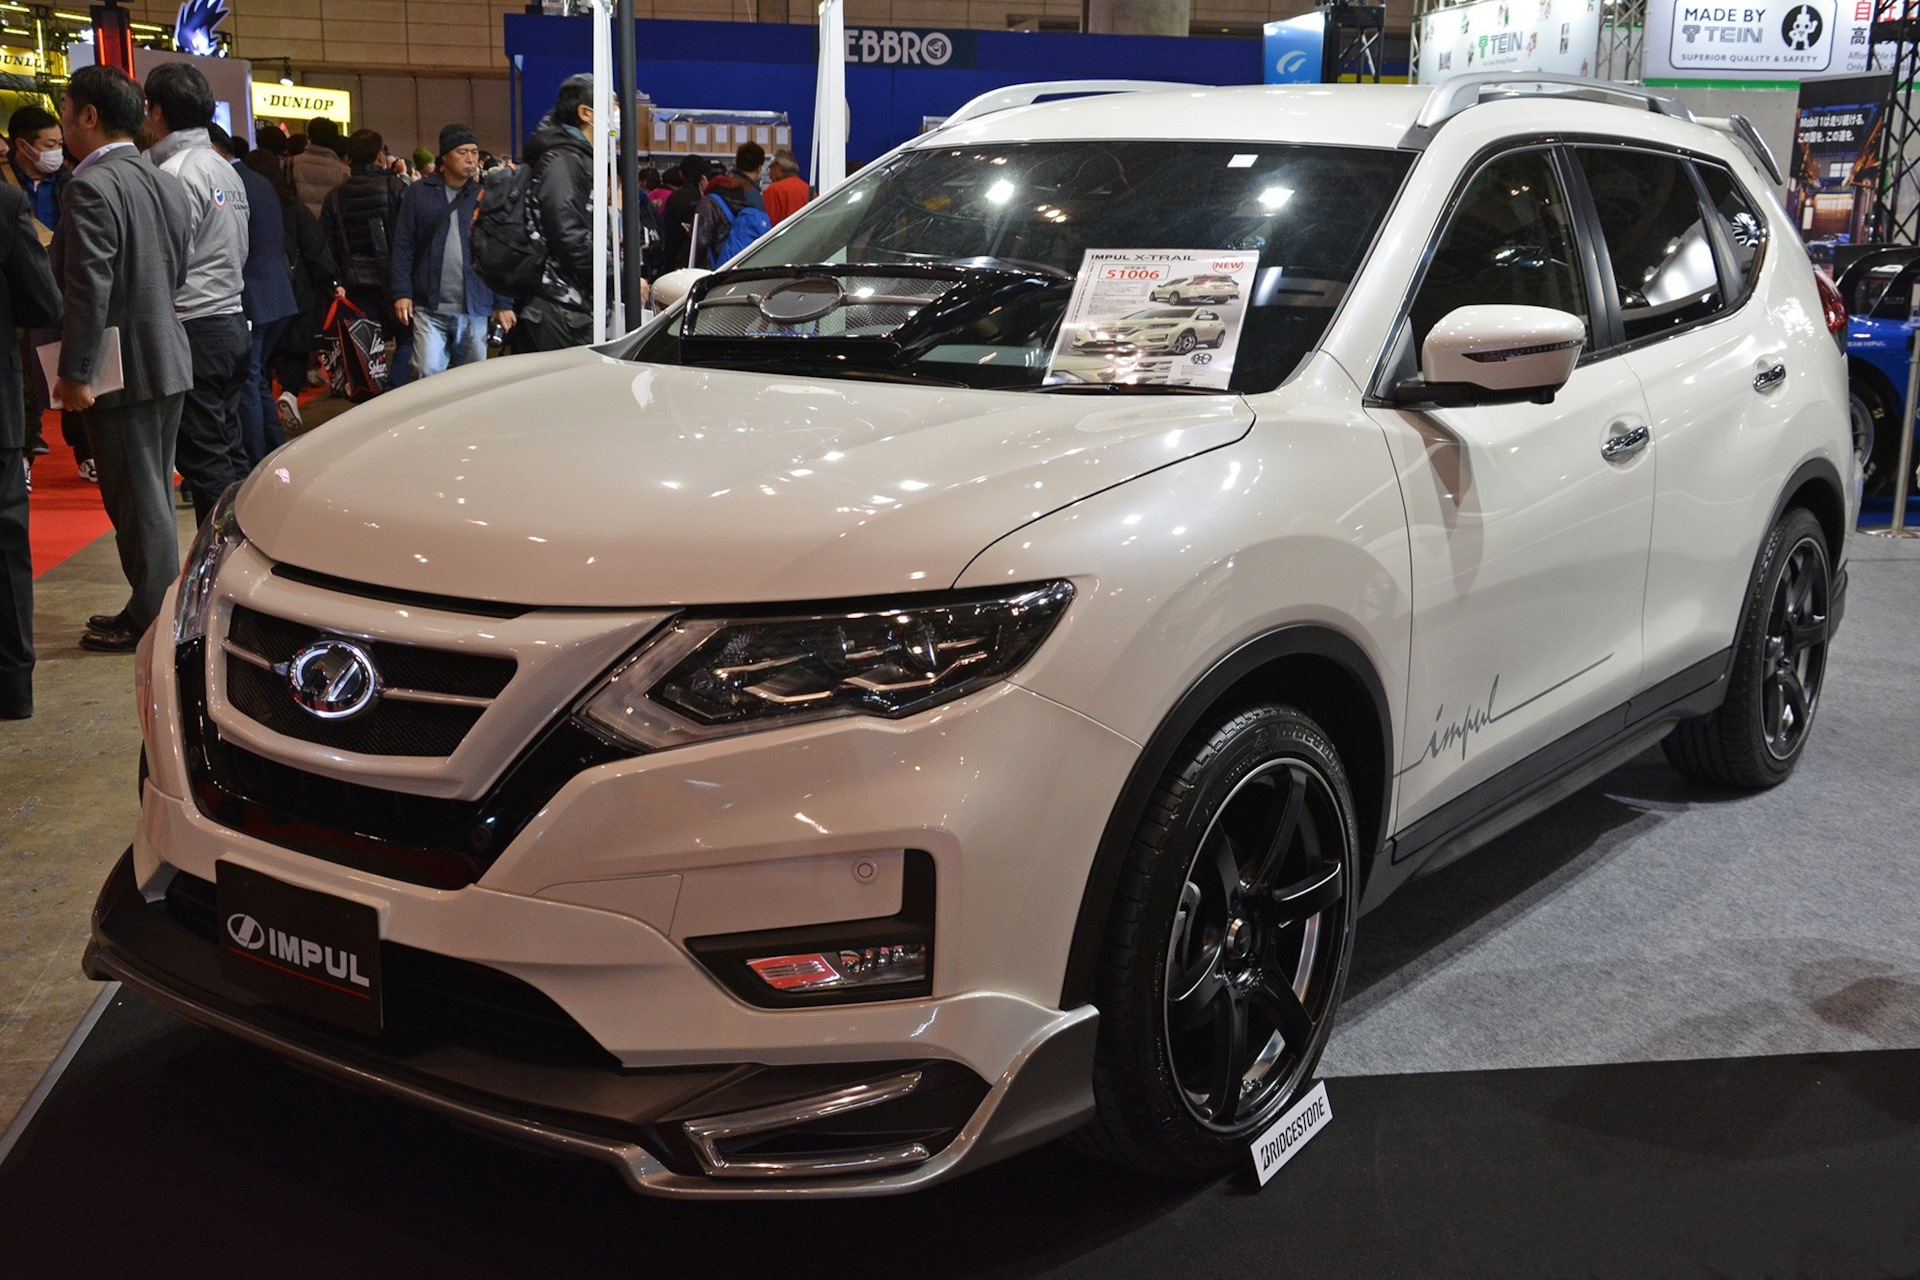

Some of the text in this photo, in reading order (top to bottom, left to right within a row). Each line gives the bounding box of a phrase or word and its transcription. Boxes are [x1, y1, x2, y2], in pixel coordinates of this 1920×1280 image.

[1684, 8, 1766, 23] MADE BY
[1490, 31, 1523, 55] TEIN
[1704, 26, 1763, 43] TEIN
[1681, 54, 1818, 63] SUPERIOR QUALITY & SAFETY
[269, 94, 334, 111] DUNLOP
[1091, 253, 1197, 262] IMPUL X-TRAIL
[1214, 260, 1244, 270] NEW
[1105, 268, 1160, 280] 51006
[1421, 673, 1500, 761] impul
[268, 926, 371, 988] IMPUL
[1260, 1095, 1326, 1172] BRIDGESTONE
